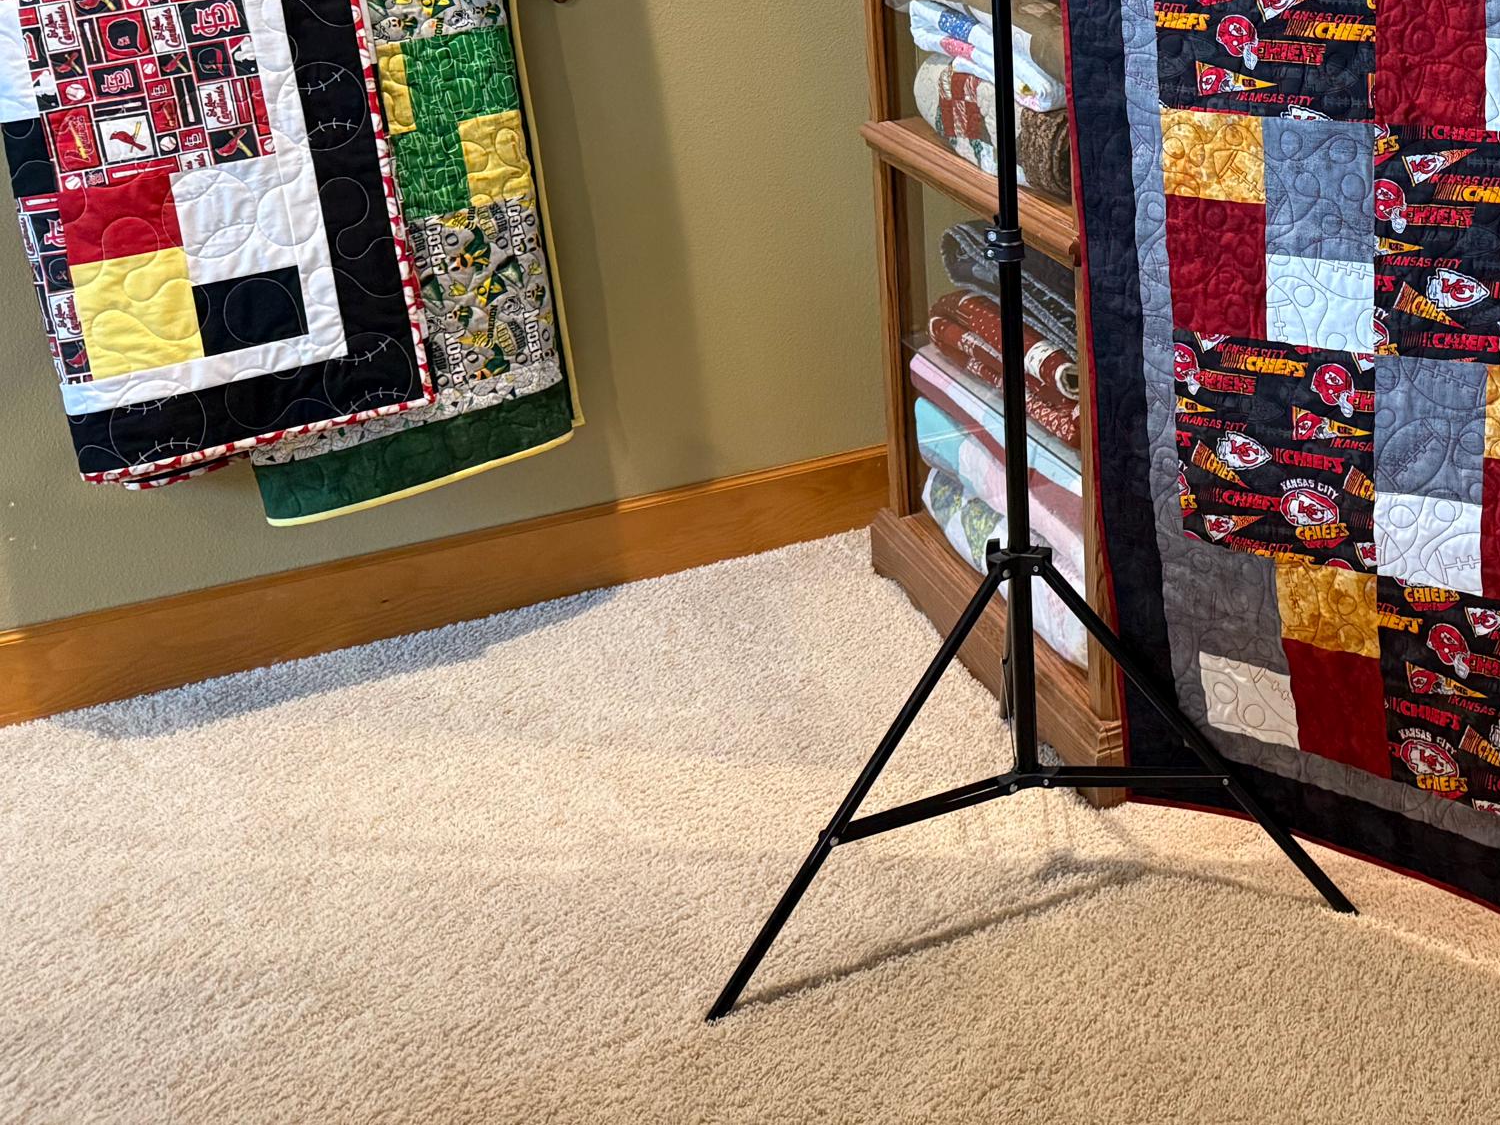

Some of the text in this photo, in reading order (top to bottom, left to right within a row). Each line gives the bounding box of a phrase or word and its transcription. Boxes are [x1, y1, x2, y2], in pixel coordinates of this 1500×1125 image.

[1240, 92, 1314, 105] KANSAS CITY
[1382, 256, 1462, 268] KANSAS CITY
[1283, 450, 1345, 474] CHIEFS
[1296, 523, 1349, 540] CHIEFS
[1417, 775, 1468, 792] CHIEFS
